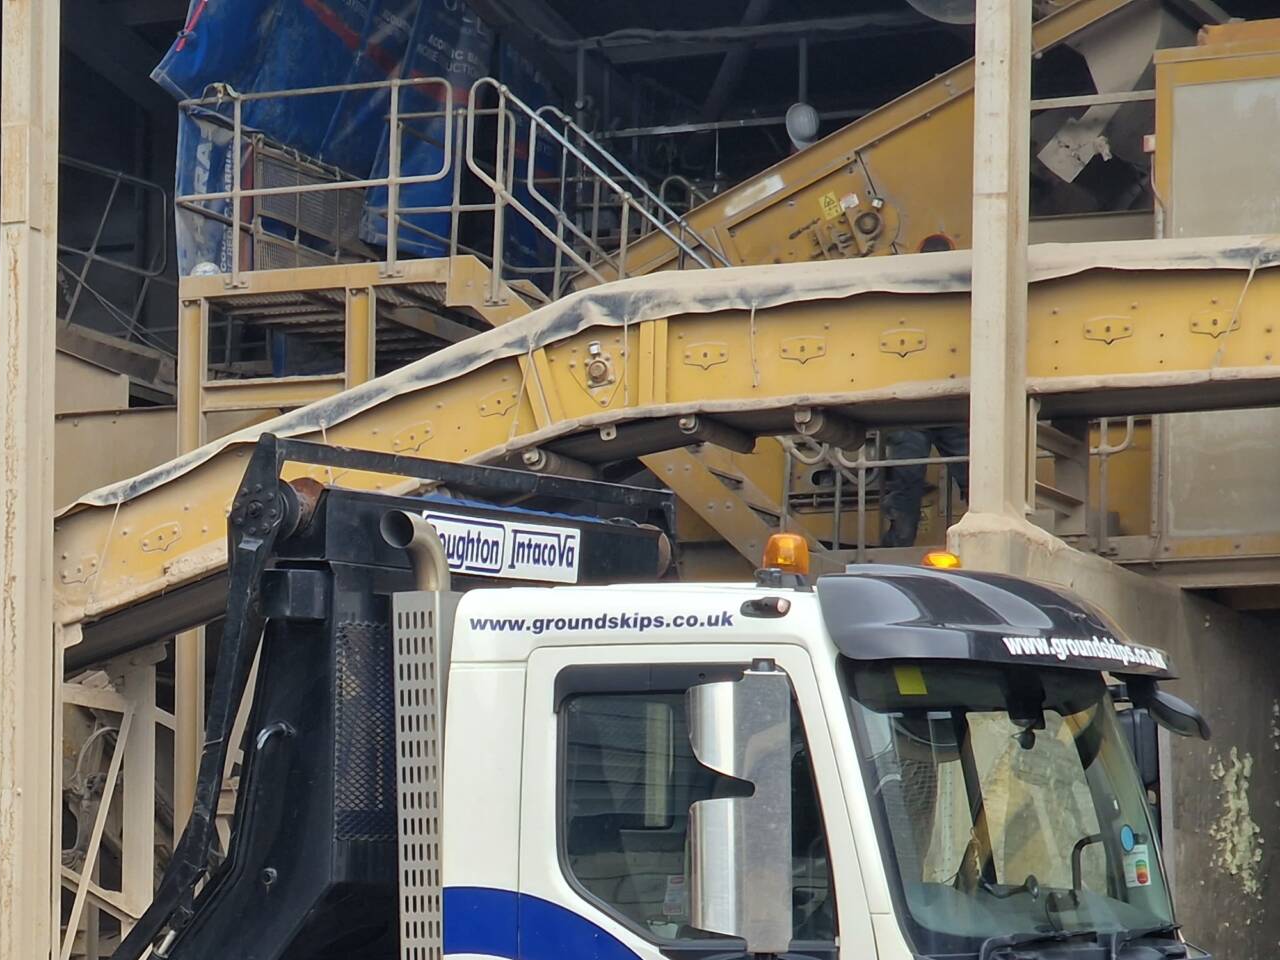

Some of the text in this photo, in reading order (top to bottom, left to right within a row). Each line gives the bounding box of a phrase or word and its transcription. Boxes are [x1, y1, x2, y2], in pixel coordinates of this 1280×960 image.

[433, 525, 576, 569] oughton IntacoVa
[470, 611, 735, 635] www.groundskips.co.uk
[1002, 636, 1168, 670] www.groundskips.co.uk
